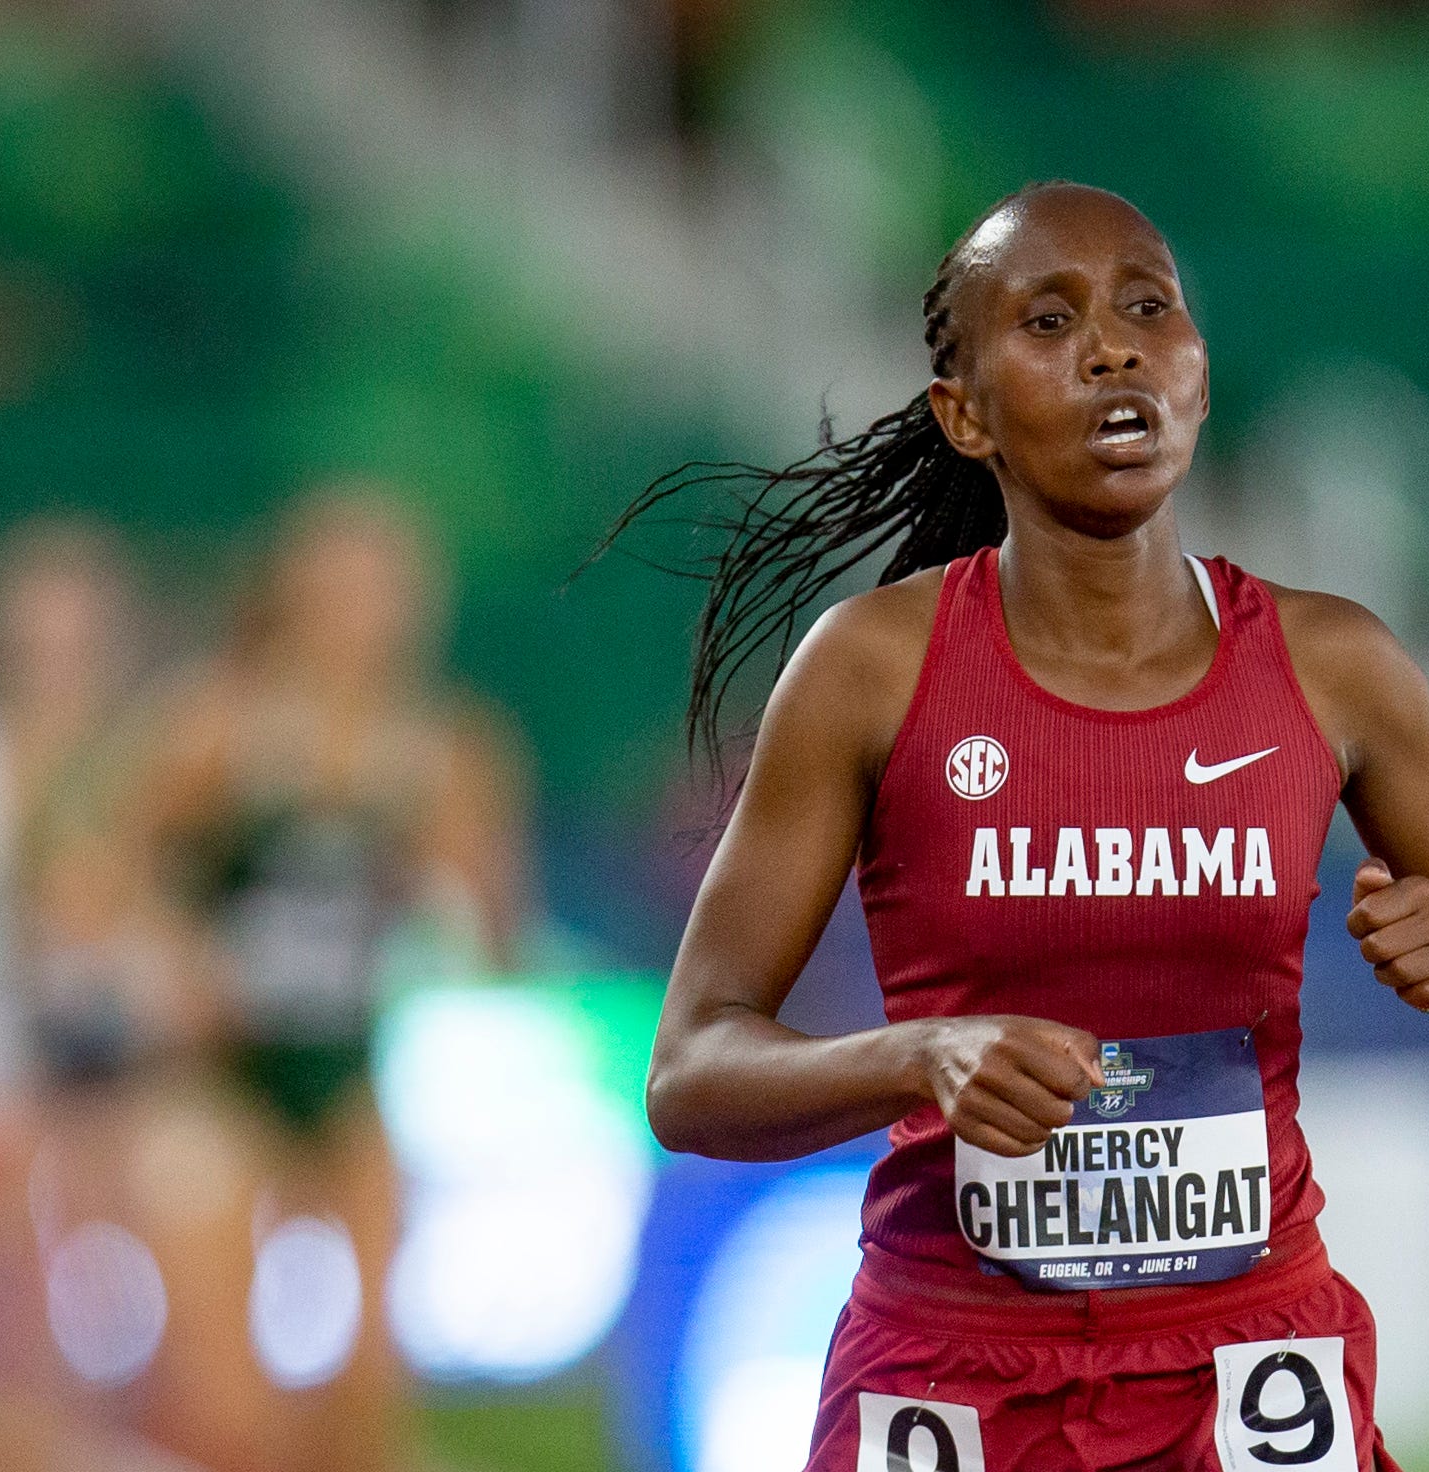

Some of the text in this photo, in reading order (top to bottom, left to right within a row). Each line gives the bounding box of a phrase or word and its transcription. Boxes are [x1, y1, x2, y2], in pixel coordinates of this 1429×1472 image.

[951, 742, 1003, 796] SEC
[965, 827, 1277, 896] ALABAMA
[1106, 1075, 1147, 1086] IONSHIPS
[1043, 1126, 1184, 1173] MERCY
[959, 1165, 1267, 1248] CHELANGAT
[1039, 1262, 1091, 1279] EUGENE,
[1094, 1261, 1113, 1276] OR
[1137, 1258, 1172, 1274] JUNE
[1240, 1351, 1335, 1465] 9
